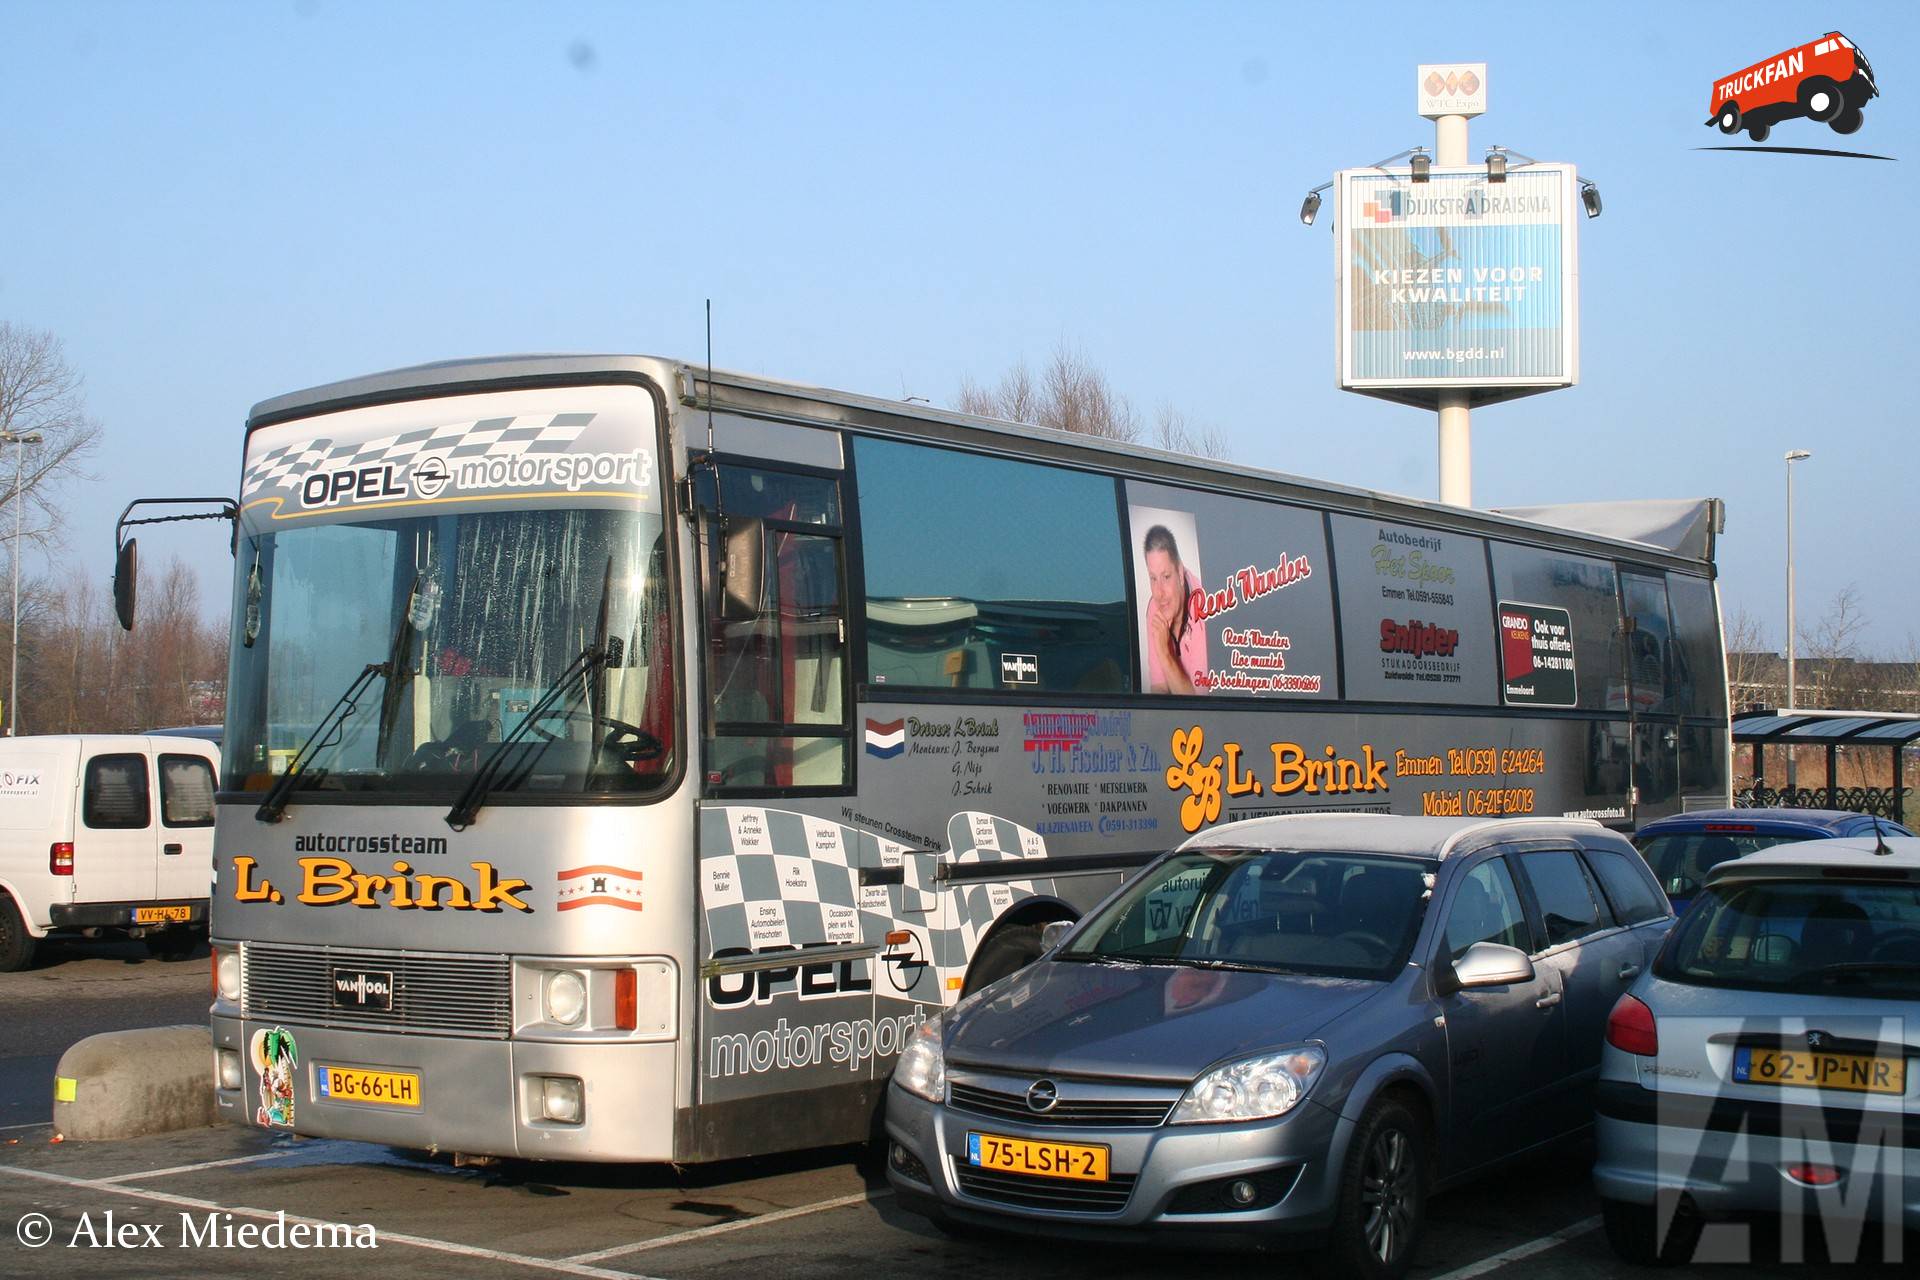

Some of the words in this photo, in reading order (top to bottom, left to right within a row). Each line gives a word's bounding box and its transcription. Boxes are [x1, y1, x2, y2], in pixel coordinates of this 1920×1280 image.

[1406, 197, 1476, 217] DIJKSTRA
[1481, 195, 1551, 214] DRAISMA
[1373, 268, 1463, 285] KIEZEN
[1473, 267, 1543, 283] VOOR
[1391, 285, 1526, 304] KWALITEIT
[1402, 347, 1504, 362] www.bgdd.nl
[303, 467, 406, 505] OPEL
[459, 452, 650, 487] motorsport
[1378, 528, 1442, 552] Autobedrijf
[1189, 576, 1237, 622] René
[1236, 552, 1311, 603] Wanders
[1381, 586, 1405, 600] Emmen
[1502, 616, 1528, 630] GRANDO
[1534, 619, 1550, 635] Ook
[1550, 624, 1565, 636] voor
[1380, 618, 1459, 660] Snijder
[1531, 635, 1548, 650] thuis
[1549, 637, 1571, 652] offerte
[964, 717, 1000, 738] Brink
[965, 741, 1000, 757] Bergsma
[1050, 743, 1066, 774] H.
[1071, 743, 1123, 774] Fischer
[1224, 742, 1264, 797] L.
[1269, 743, 1389, 796] Brink
[1395, 749, 1443, 777] Emmen
[1501, 748, 1545, 774] 624264
[1047, 782, 1090, 796] RENOVATIE
[1100, 782, 1148, 794] METSELWERK
[1047, 801, 1091, 815] VOEGWERK
[1100, 800, 1148, 814] DAKPANNEN
[1422, 789, 1463, 817] Mobiel
[741, 814, 758, 824] Jeffrey
[841, 806, 853, 822] Wij
[854, 813, 883, 831] steunen
[884, 821, 922, 845] Crossteam
[923, 836, 942, 851] Brink
[743, 826, 762, 835] Anneke
[295, 833, 448, 855] autocrossteam
[713, 871, 730, 881] Bennie
[792, 866, 801, 876] Rik
[232, 856, 285, 904] L.
[297, 855, 535, 914] Brink
[785, 879, 808, 888] Hoekstra
[759, 907, 776, 916] Ensing
[708, 942, 873, 1006] OPEL
[709, 1004, 928, 1080] motorsport
[1735, 1066, 1748, 1076] NL
[1759, 1053, 1890, 1088] 62-JP-NR
[332, 1073, 413, 1099] BG-66-LH
[971, 1152, 980, 1161] NL
[987, 1141, 1097, 1176] 75-LSH-2
